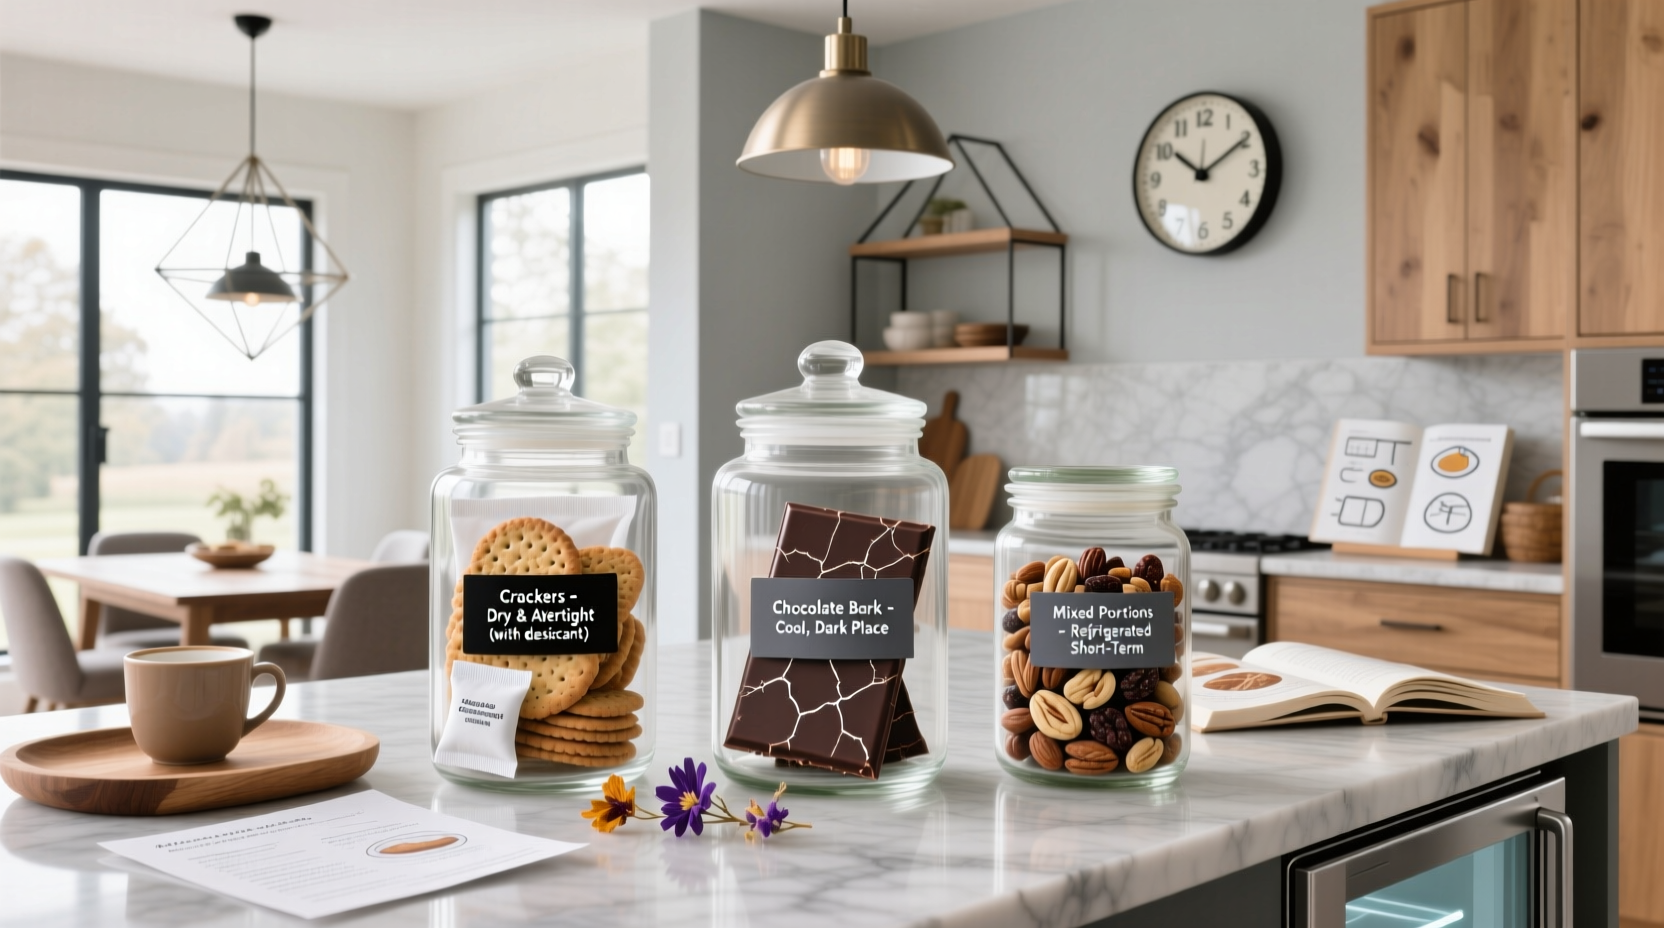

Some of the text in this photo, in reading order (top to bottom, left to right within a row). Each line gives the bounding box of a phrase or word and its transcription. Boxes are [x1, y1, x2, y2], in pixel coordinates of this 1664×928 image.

[1196, 108, 1214, 128] 12
[1225, 113, 1231, 131] 1
[1175, 118, 1188, 138] 11
[1240, 130, 1251, 149] 2
[1156, 142, 1174, 161] 10
[1248, 159, 1260, 178] 3
[1150, 171, 1162, 189] 9
[1158, 199, 1167, 217] 8
[1239, 189, 1251, 208] 4
[1175, 217, 1184, 237] 7
[1222, 211, 1233, 230] 5
[1197, 221, 1209, 240] 6
[499, 588, 566, 604] Crackers
[772, 599, 844, 615] Chocolate
[848, 599, 883, 615] Bark
[1053, 605, 1154, 620] Mixed Portions
[487, 608, 511, 627] Dry
[516, 608, 527, 623] &
[489, 626, 521, 643] (with
[775, 619, 889, 637] Cool, Dark Place
[1071, 622, 1152, 641] Refrigerated
[1070, 640, 1144, 655] Short-Term
